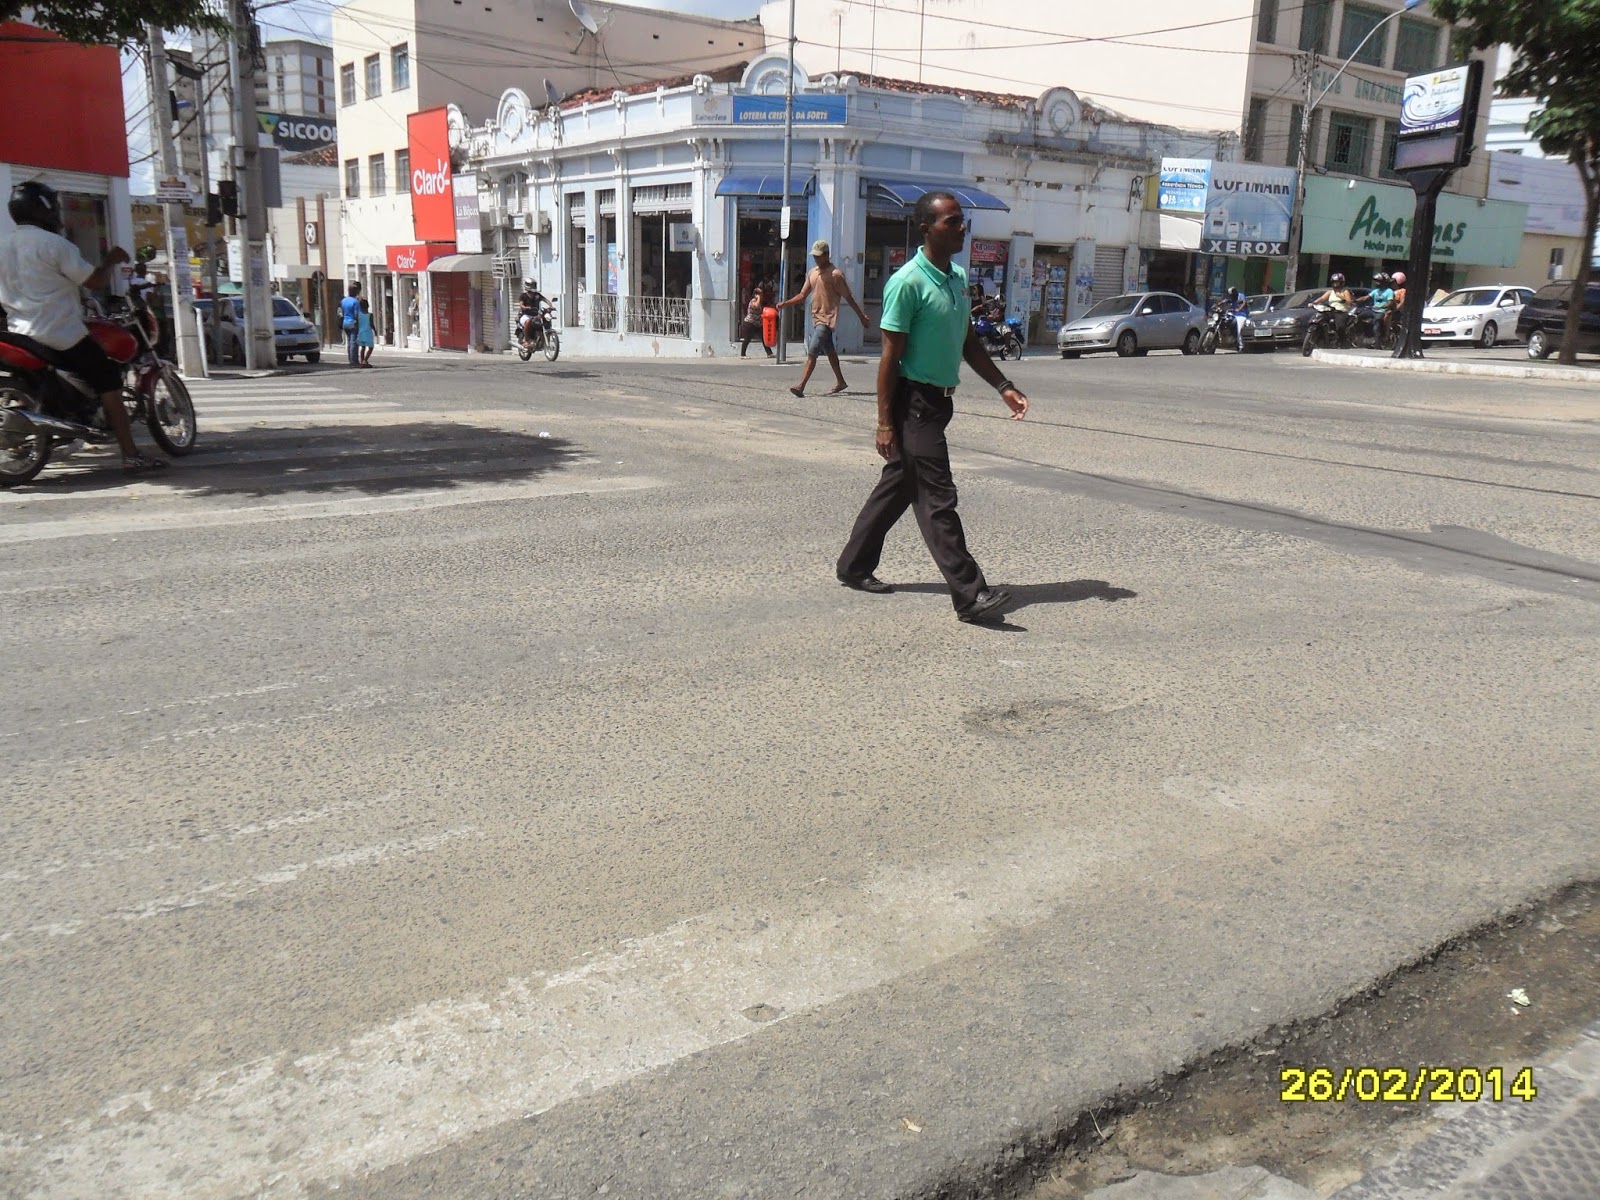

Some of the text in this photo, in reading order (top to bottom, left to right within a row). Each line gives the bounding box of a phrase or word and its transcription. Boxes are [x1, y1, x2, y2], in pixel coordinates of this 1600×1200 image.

[739, 111, 766, 120] LOTERIA
[796, 111, 805, 120] DA
[807, 110, 828, 120] SORTE
[413, 162, 449, 195] Claro
[1209, 240, 1281, 255] XEROX
[1363, 240, 1385, 251] Moda
[1386, 243, 1404, 254] para
[396, 252, 416, 269] Claro
